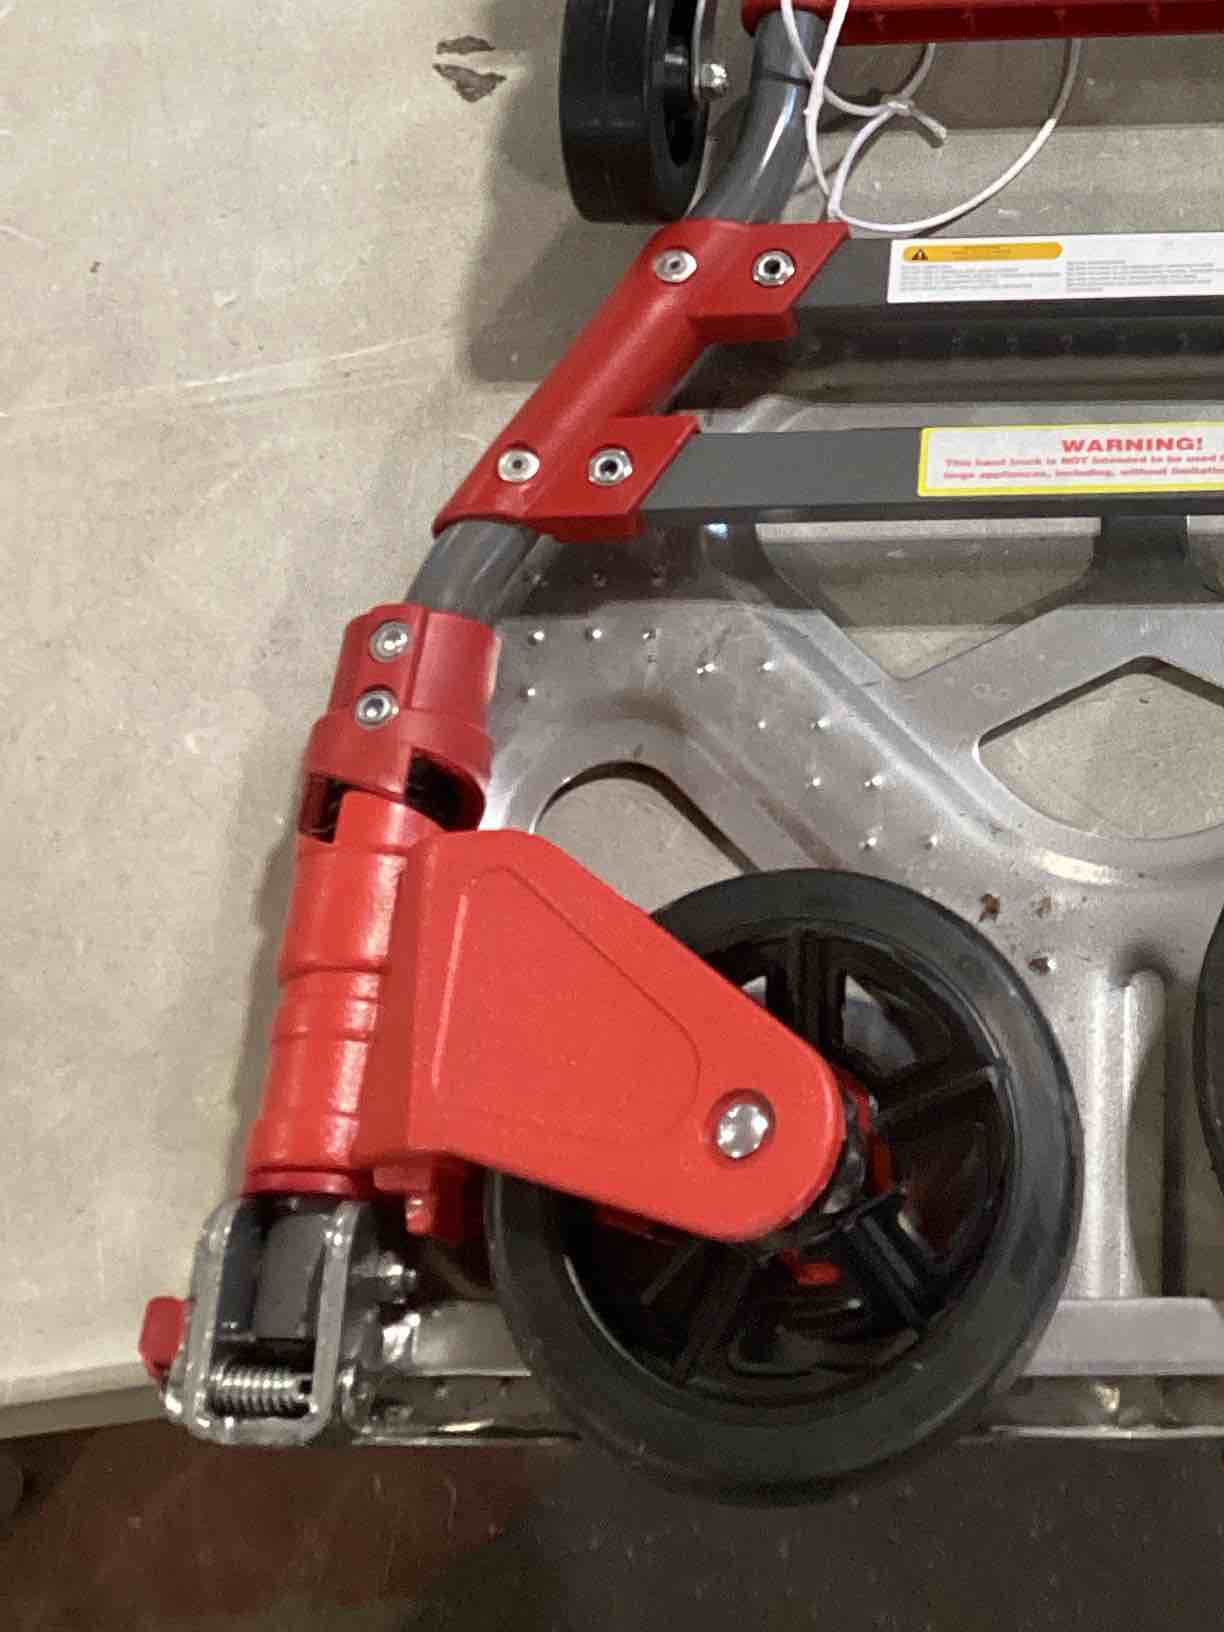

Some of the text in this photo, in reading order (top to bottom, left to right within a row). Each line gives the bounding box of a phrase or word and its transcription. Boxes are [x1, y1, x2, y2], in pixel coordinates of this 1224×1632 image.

[1061, 437, 1203, 452] WARNING!
[945, 457, 971, 467] This
[1046, 456, 1056, 465] is
[1061, 456, 1089, 465] NOT
